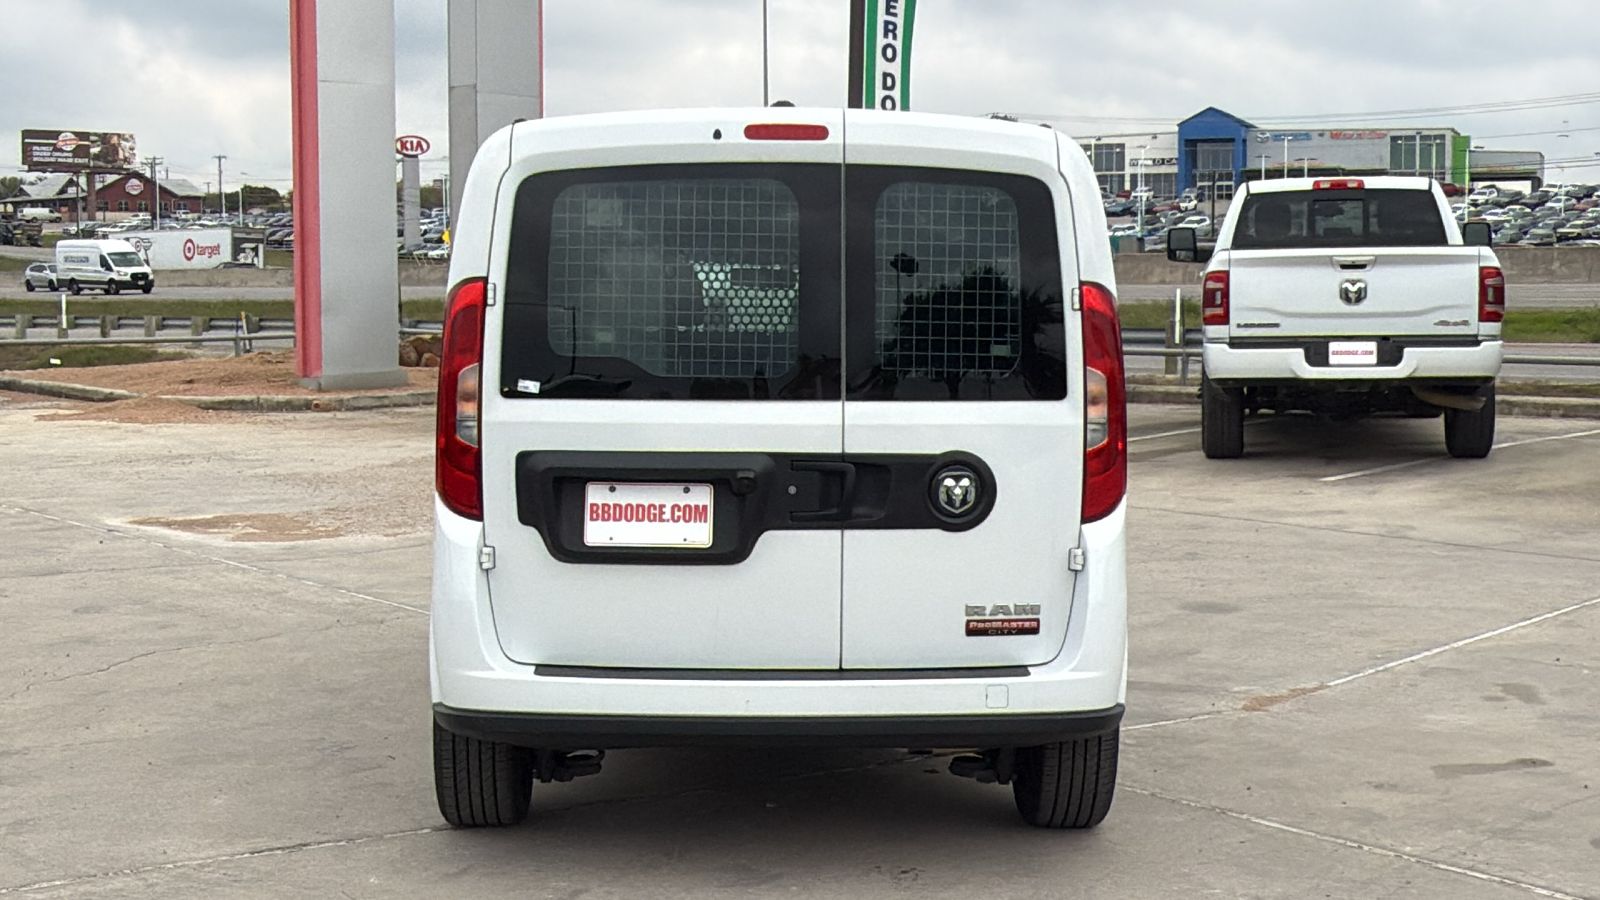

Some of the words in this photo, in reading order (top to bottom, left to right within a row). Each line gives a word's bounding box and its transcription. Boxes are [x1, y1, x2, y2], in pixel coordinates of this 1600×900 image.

[400, 140, 424, 152] KIA
[196, 243, 221, 258] target
[589, 503, 708, 523] BBDODGE.COM
[965, 603, 1041, 617] RAM
